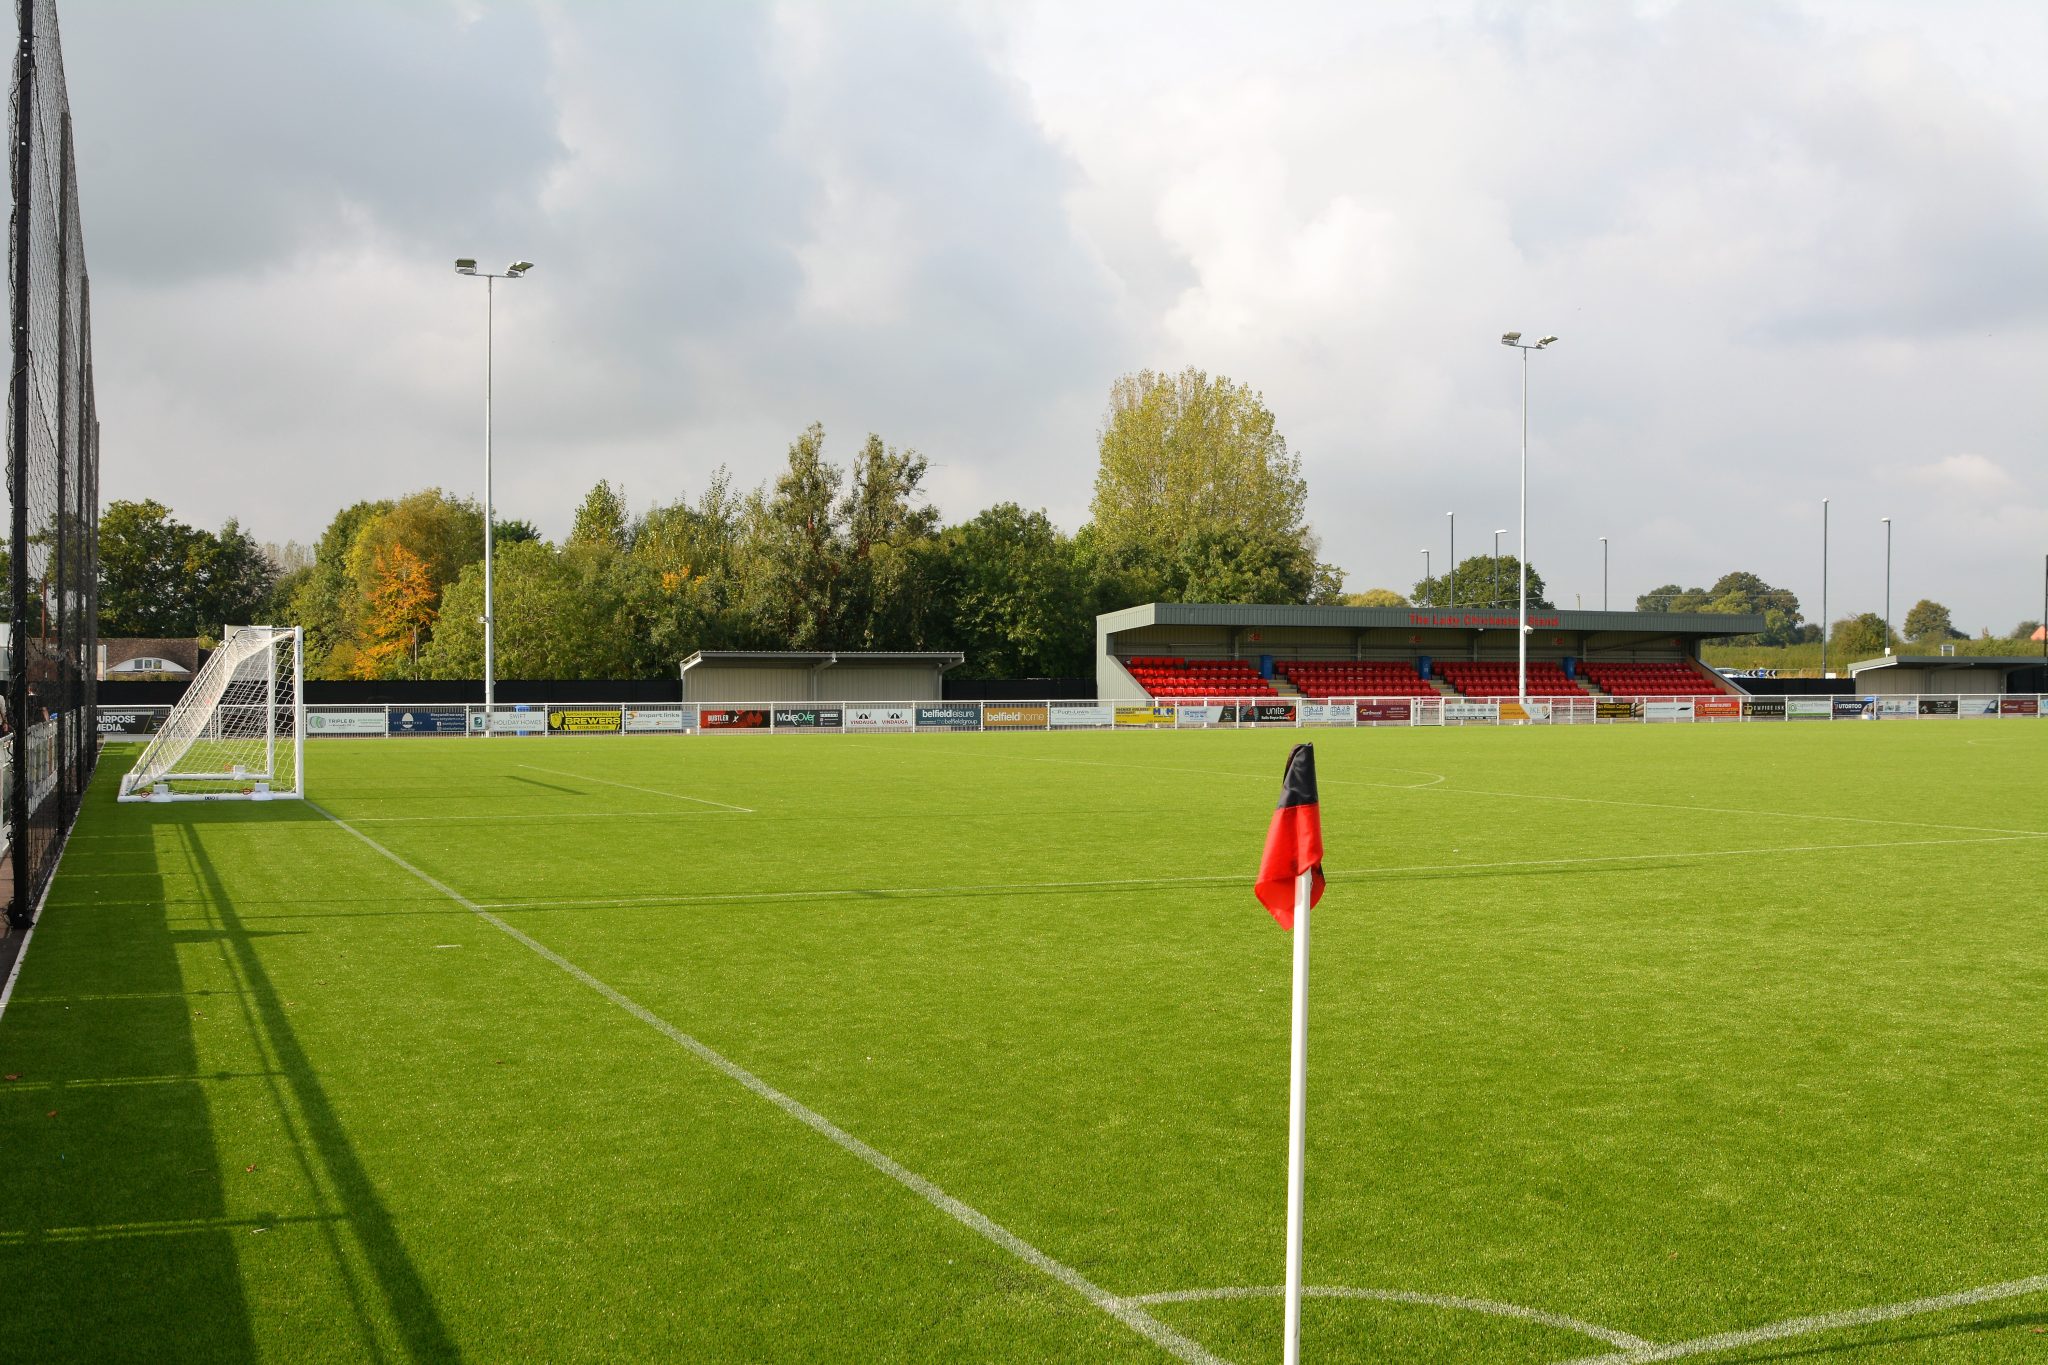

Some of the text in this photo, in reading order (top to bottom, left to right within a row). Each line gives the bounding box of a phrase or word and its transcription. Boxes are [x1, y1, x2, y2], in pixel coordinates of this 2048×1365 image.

[1409, 614, 1559, 627] The Lady Chicheste Stand
[1265, 707, 1285, 715] unite
[565, 717, 621, 725] BREWERS
